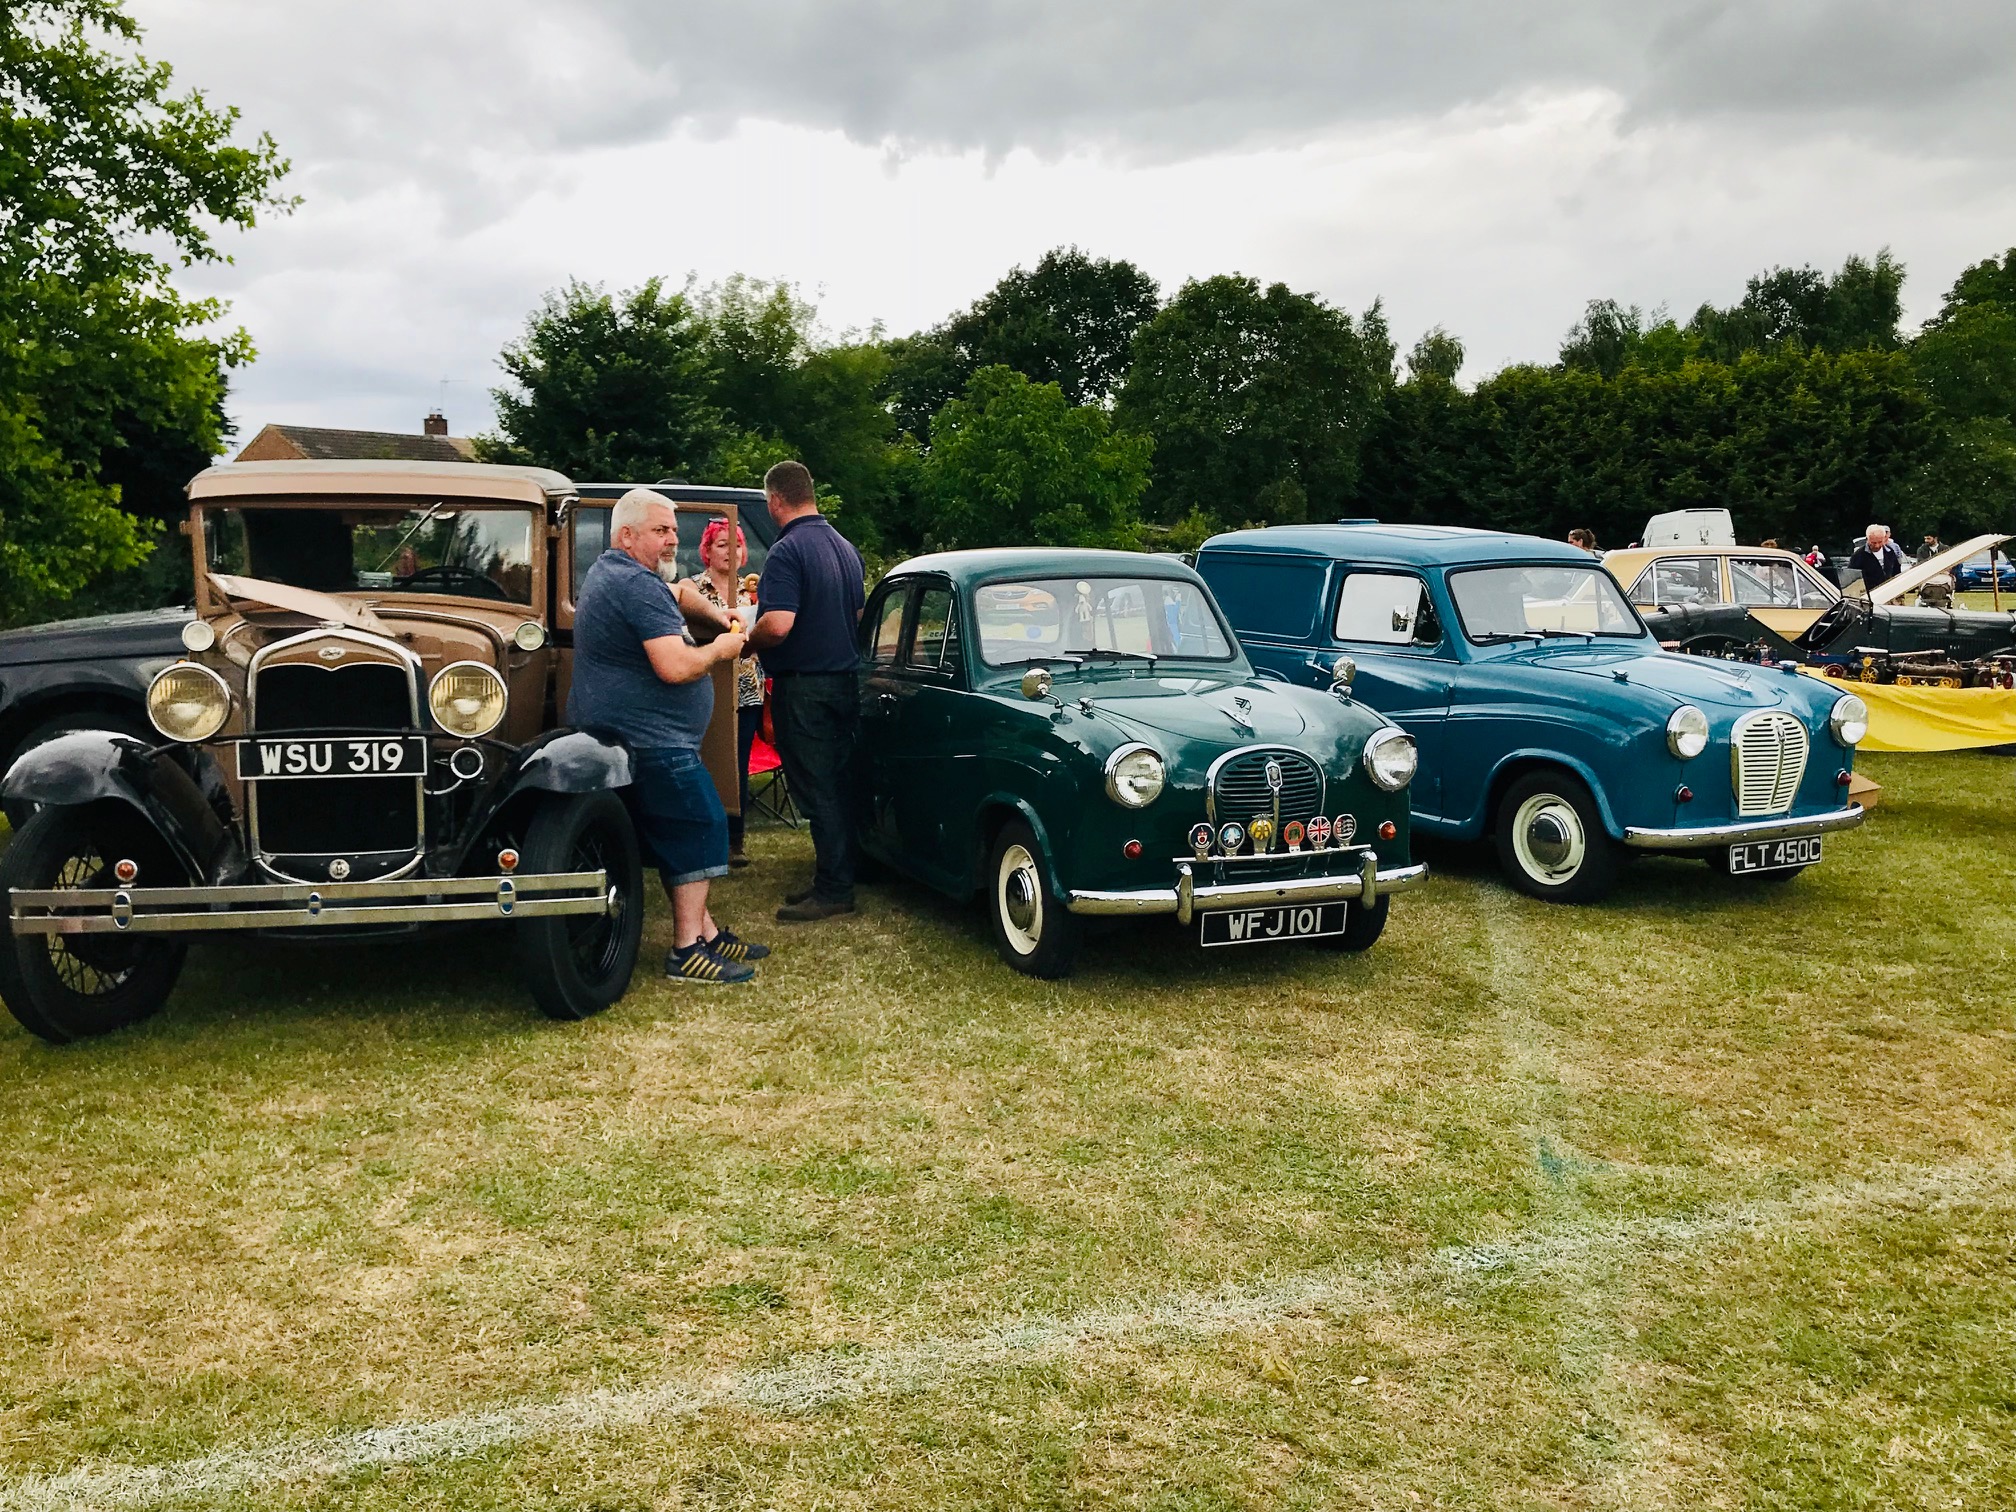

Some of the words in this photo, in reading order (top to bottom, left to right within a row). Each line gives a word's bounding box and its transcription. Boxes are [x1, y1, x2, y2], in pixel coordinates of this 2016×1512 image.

[259, 743, 333, 775] WSU
[347, 742, 404, 772] 319
[1732, 844, 1770, 870] FLT
[1774, 838, 1820, 864] 450C
